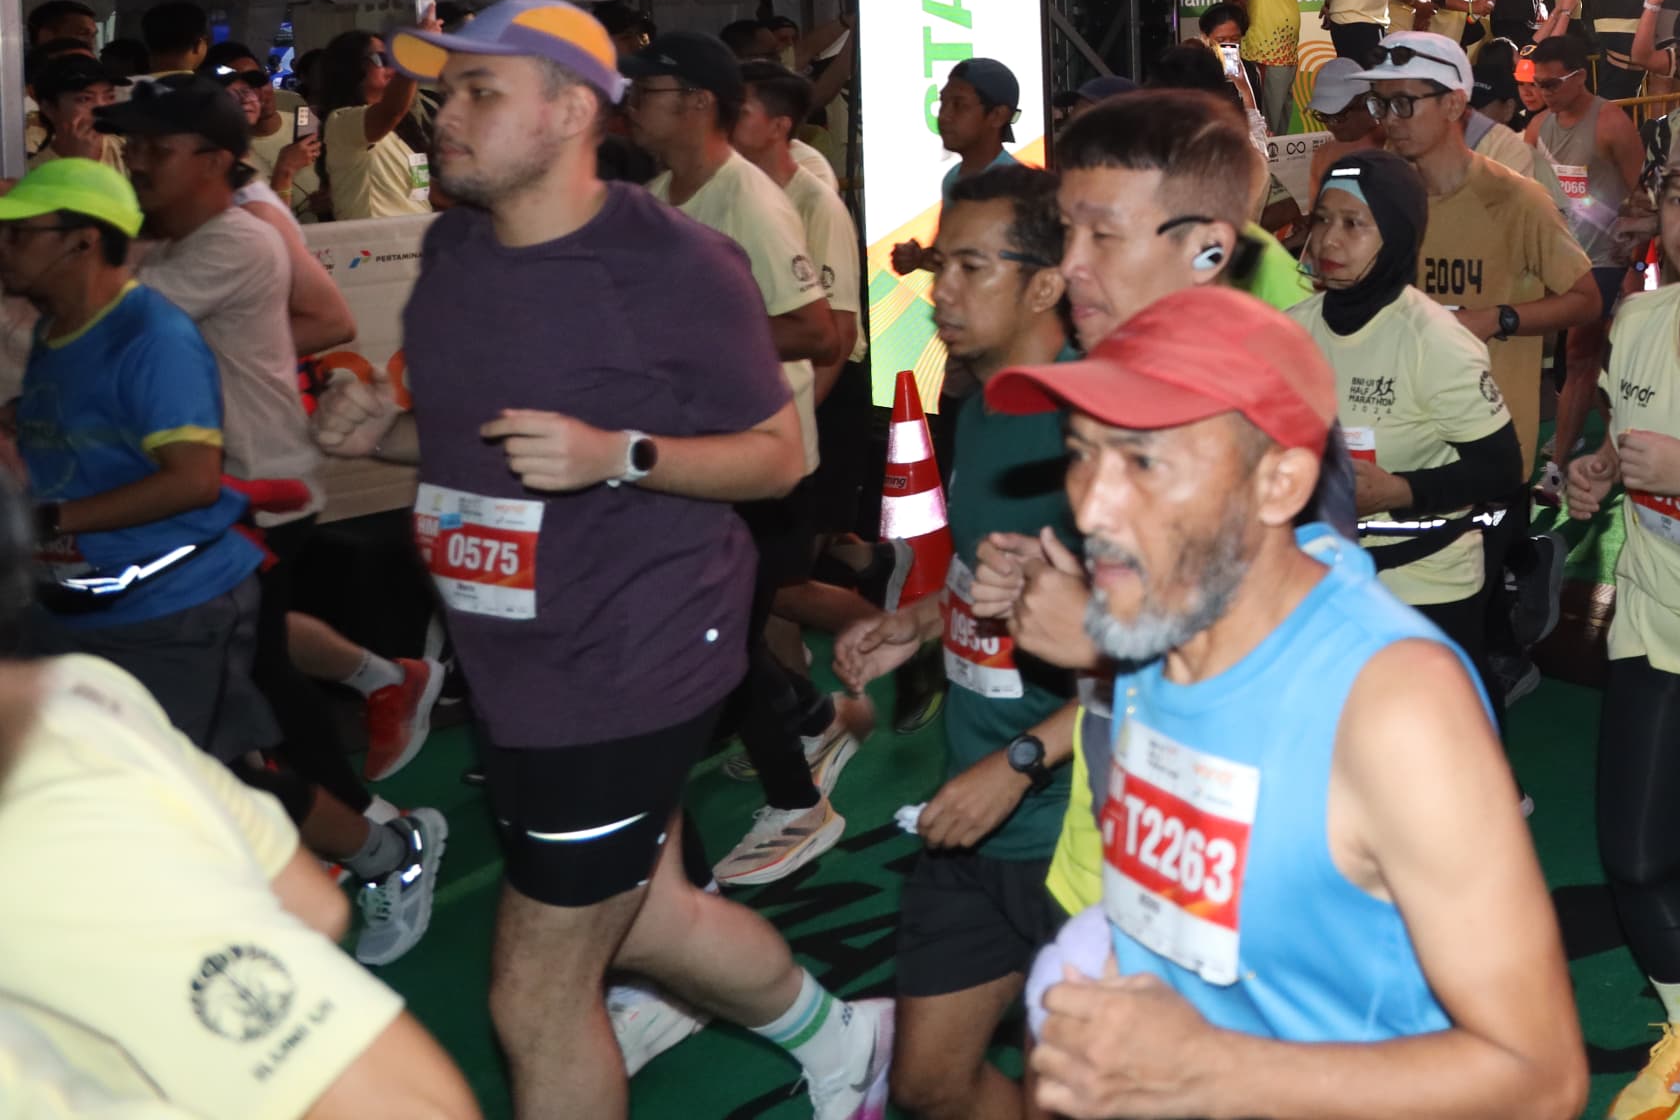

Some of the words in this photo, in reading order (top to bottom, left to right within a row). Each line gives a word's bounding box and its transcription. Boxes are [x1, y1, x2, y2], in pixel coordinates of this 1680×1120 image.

[1425, 258, 1483, 295] 2004
[447, 532, 519, 576] 0575
[1125, 793, 1236, 904] T2263
